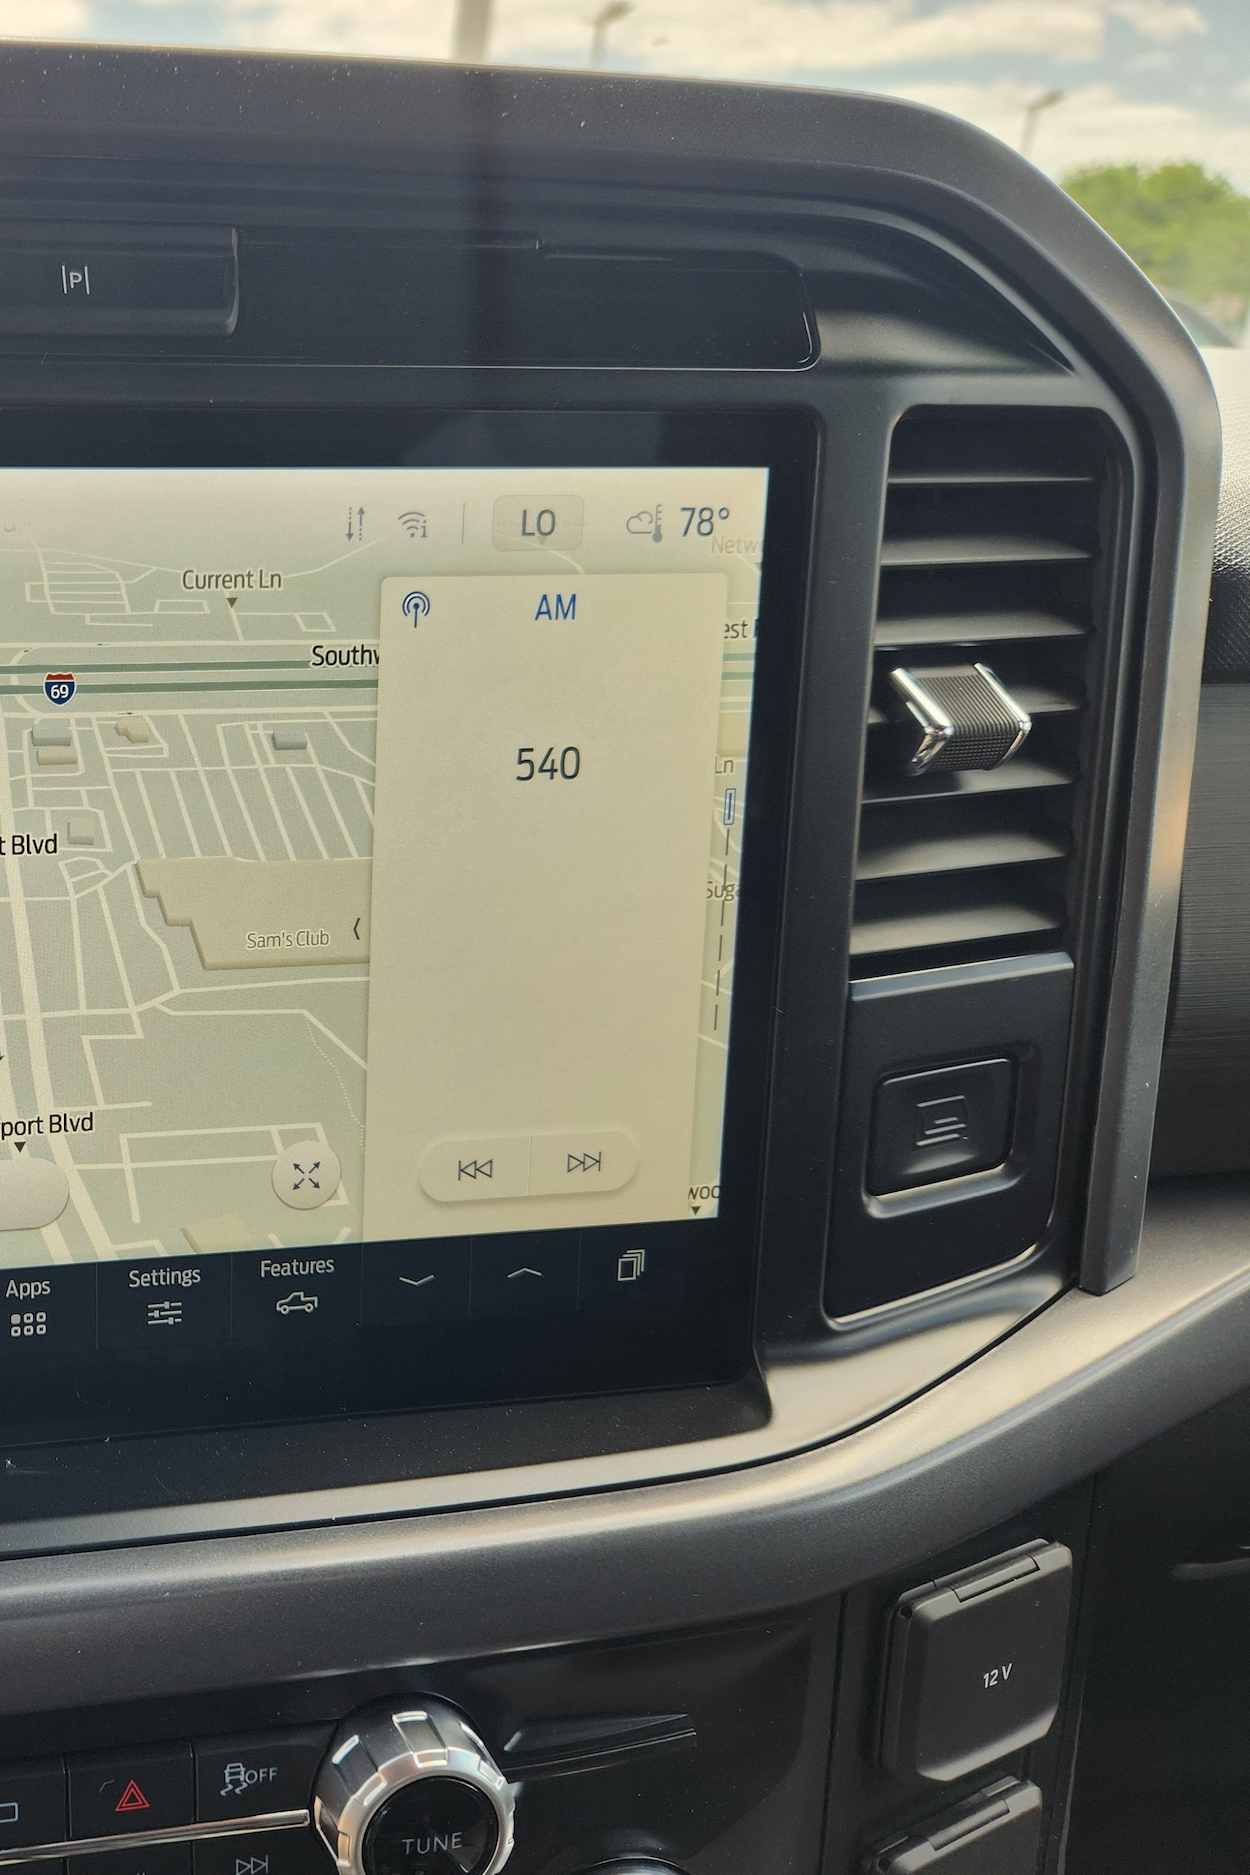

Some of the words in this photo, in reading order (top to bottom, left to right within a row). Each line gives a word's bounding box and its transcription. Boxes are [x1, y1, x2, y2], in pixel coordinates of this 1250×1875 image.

[521, 509, 556, 537] LO
[182, 569, 256, 590] Current
[259, 569, 282, 589] Ln
[534, 593, 577, 621] AM
[50, 684, 70, 700] 69
[515, 746, 581, 782] 540
[11, 833, 58, 856] Blvd
[706, 880, 739, 902] Sug
[246, 931, 293, 949] Sam's
[296, 929, 330, 946] Club
[49, 1111, 94, 1135] Blvd
[128, 1265, 201, 1290] Settings
[260, 1255, 335, 1278] Features
[5, 1277, 51, 1302] Apps
[983, 1668, 999, 1689] 12
[1001, 1662, 1013, 1681] V
[244, 1766, 278, 1785] OFF
[401, 1831, 463, 1856] TUNE
